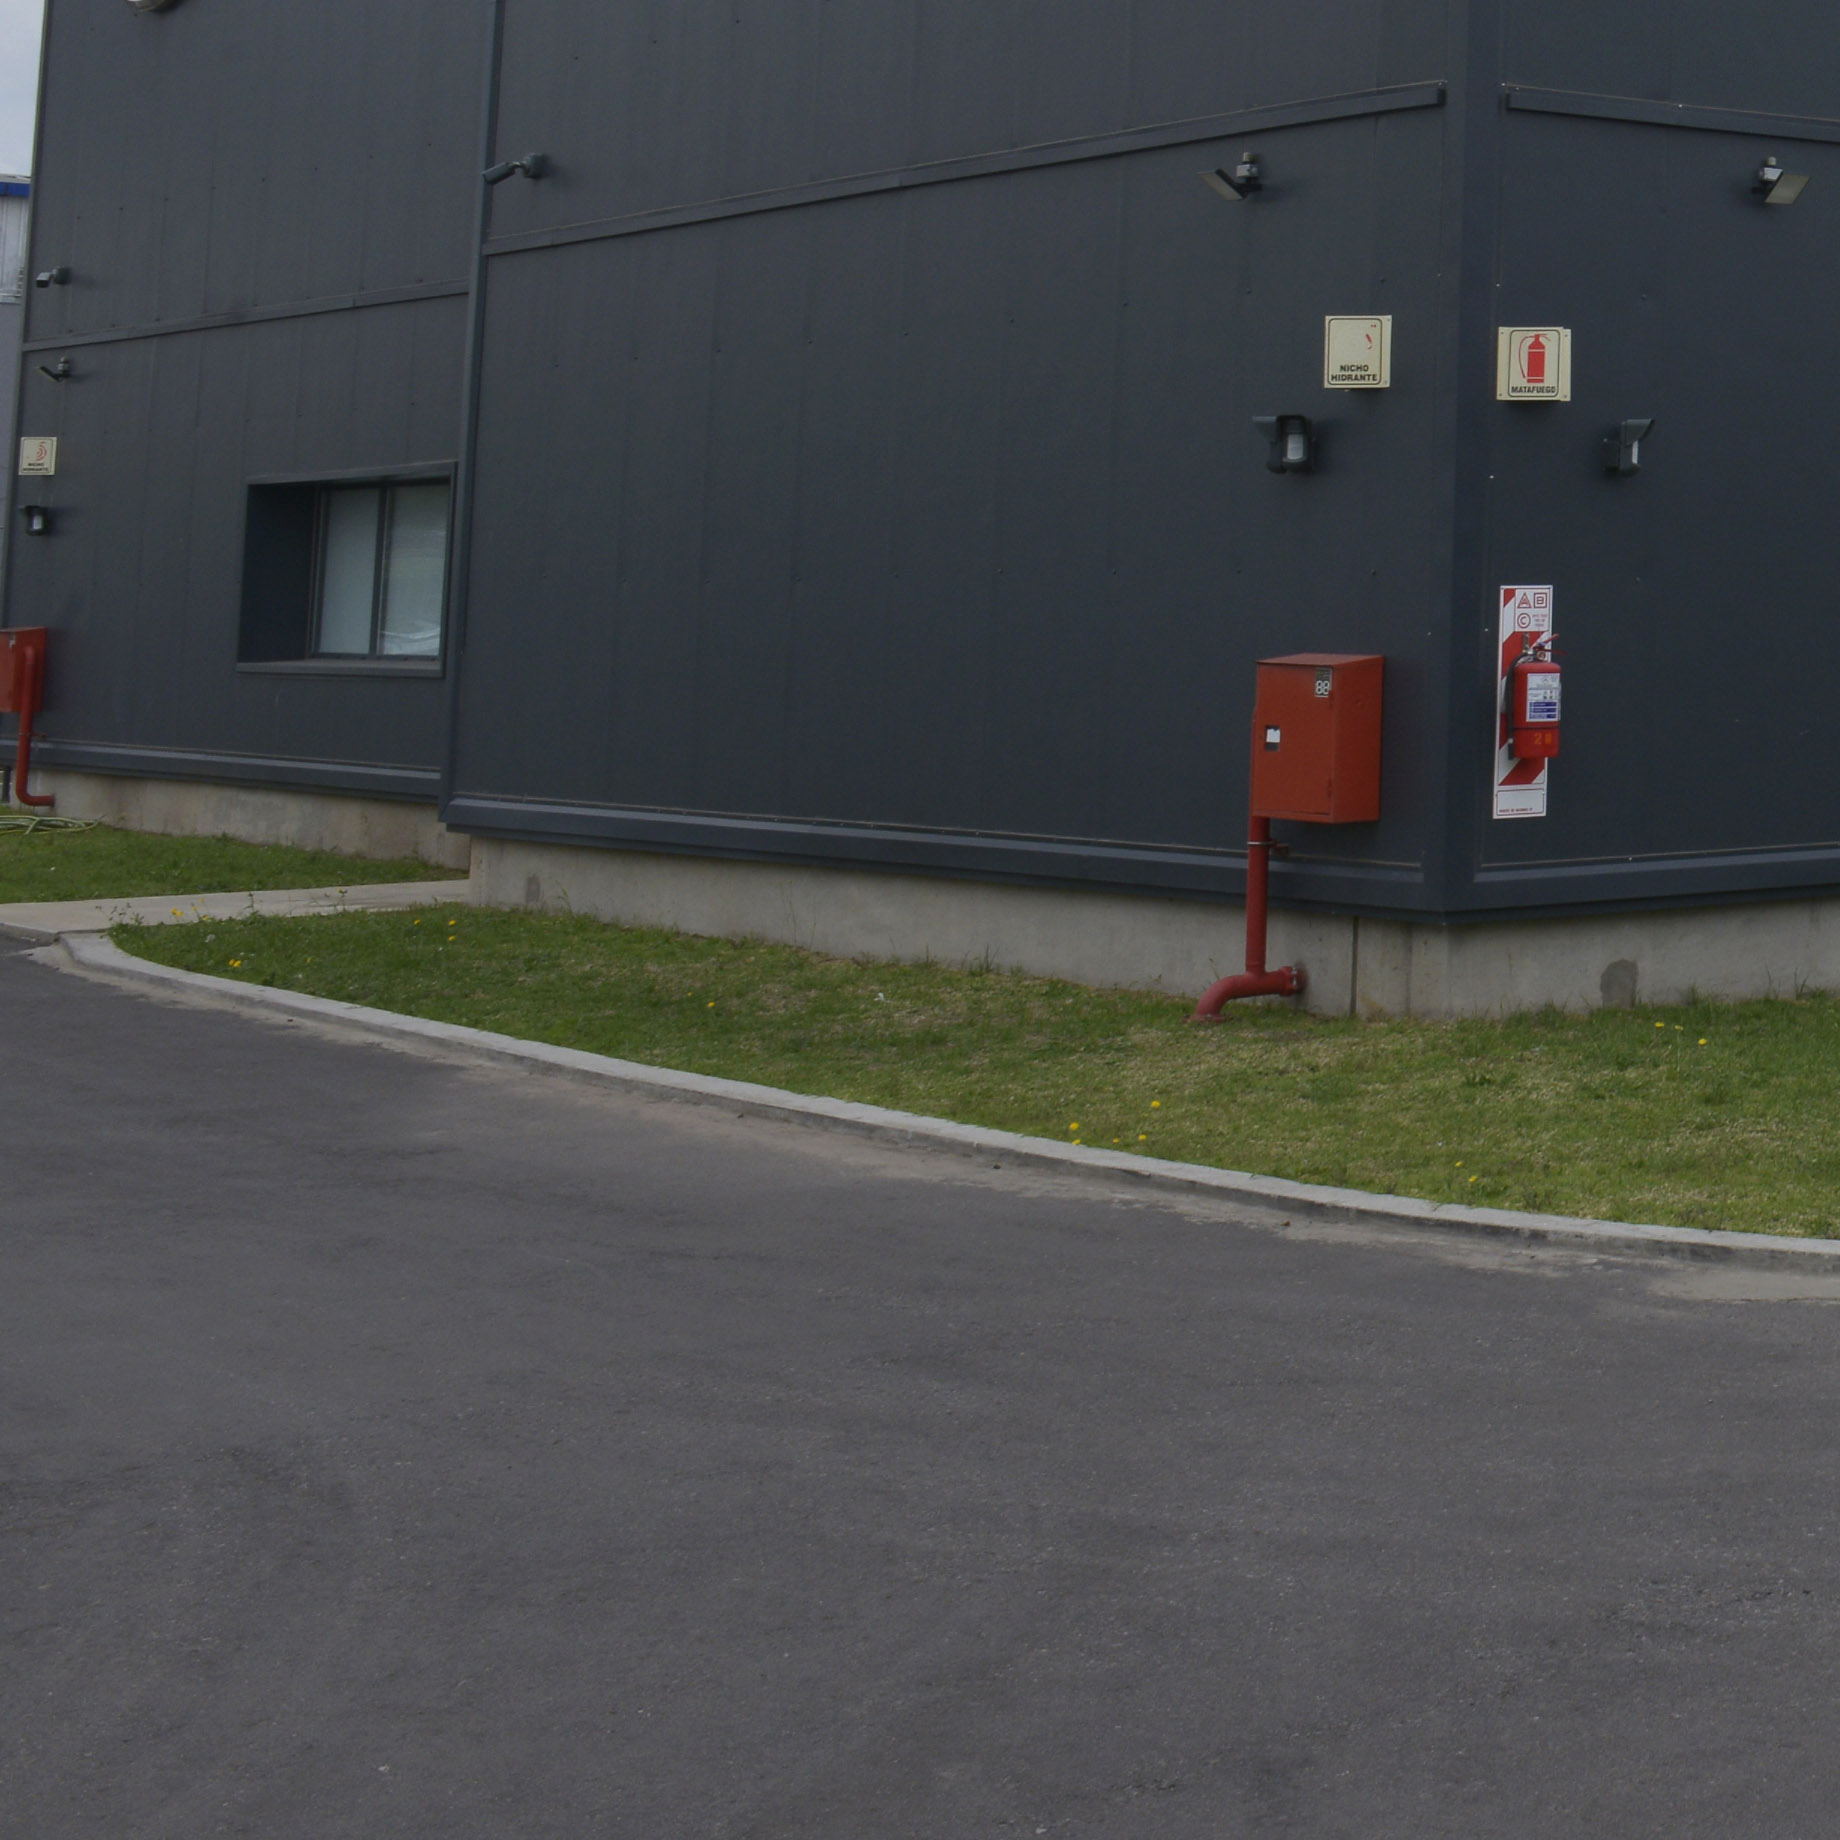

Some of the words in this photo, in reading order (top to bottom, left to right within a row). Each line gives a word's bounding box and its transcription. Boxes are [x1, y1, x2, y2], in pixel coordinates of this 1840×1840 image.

[1340, 364, 1369, 372] NICHO
[1330, 373, 1378, 381] HIDRANTE
[1511, 385, 1556, 394] MATAFUEGO
